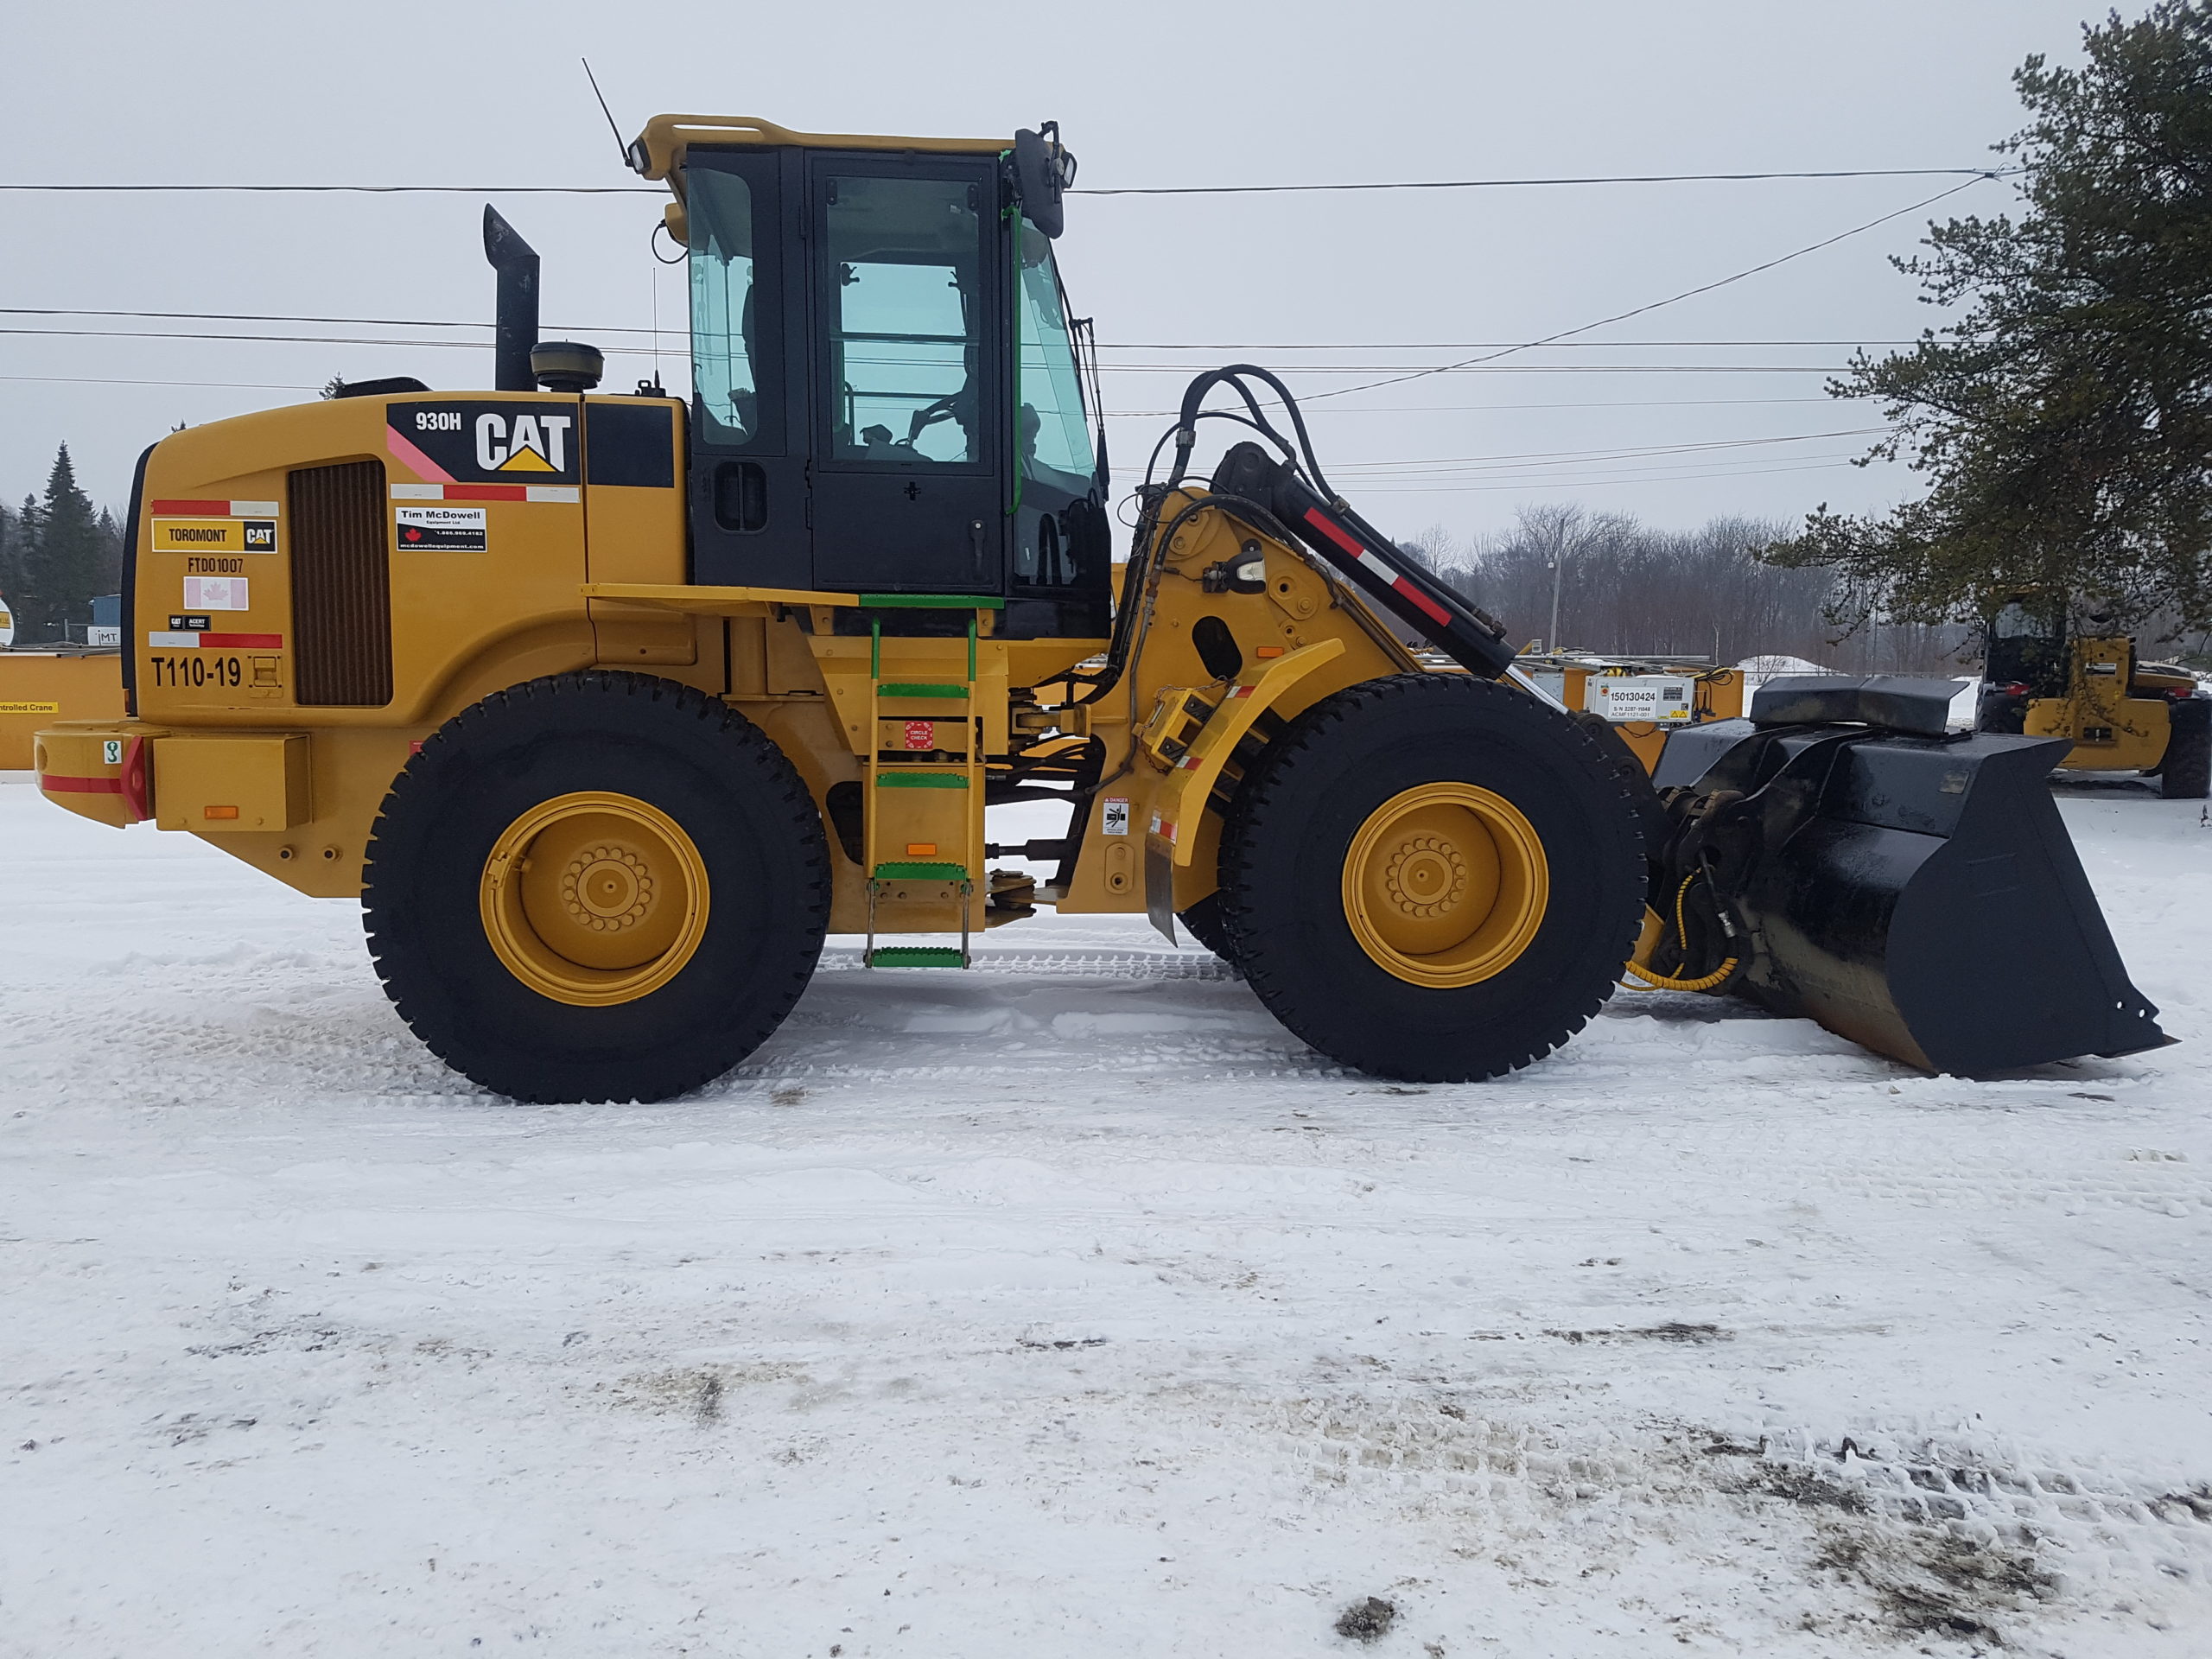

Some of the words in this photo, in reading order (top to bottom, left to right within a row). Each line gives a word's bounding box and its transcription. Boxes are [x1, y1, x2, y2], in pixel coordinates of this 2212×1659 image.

[416, 412, 461, 430] 930H
[476, 413, 571, 472] CAT
[426, 511, 480, 519] McDowell
[168, 528, 226, 542] TOROMONT
[246, 529, 272, 543] CAT
[151, 657, 241, 687] T110-19
[1611, 692, 1656, 701] 150130424
